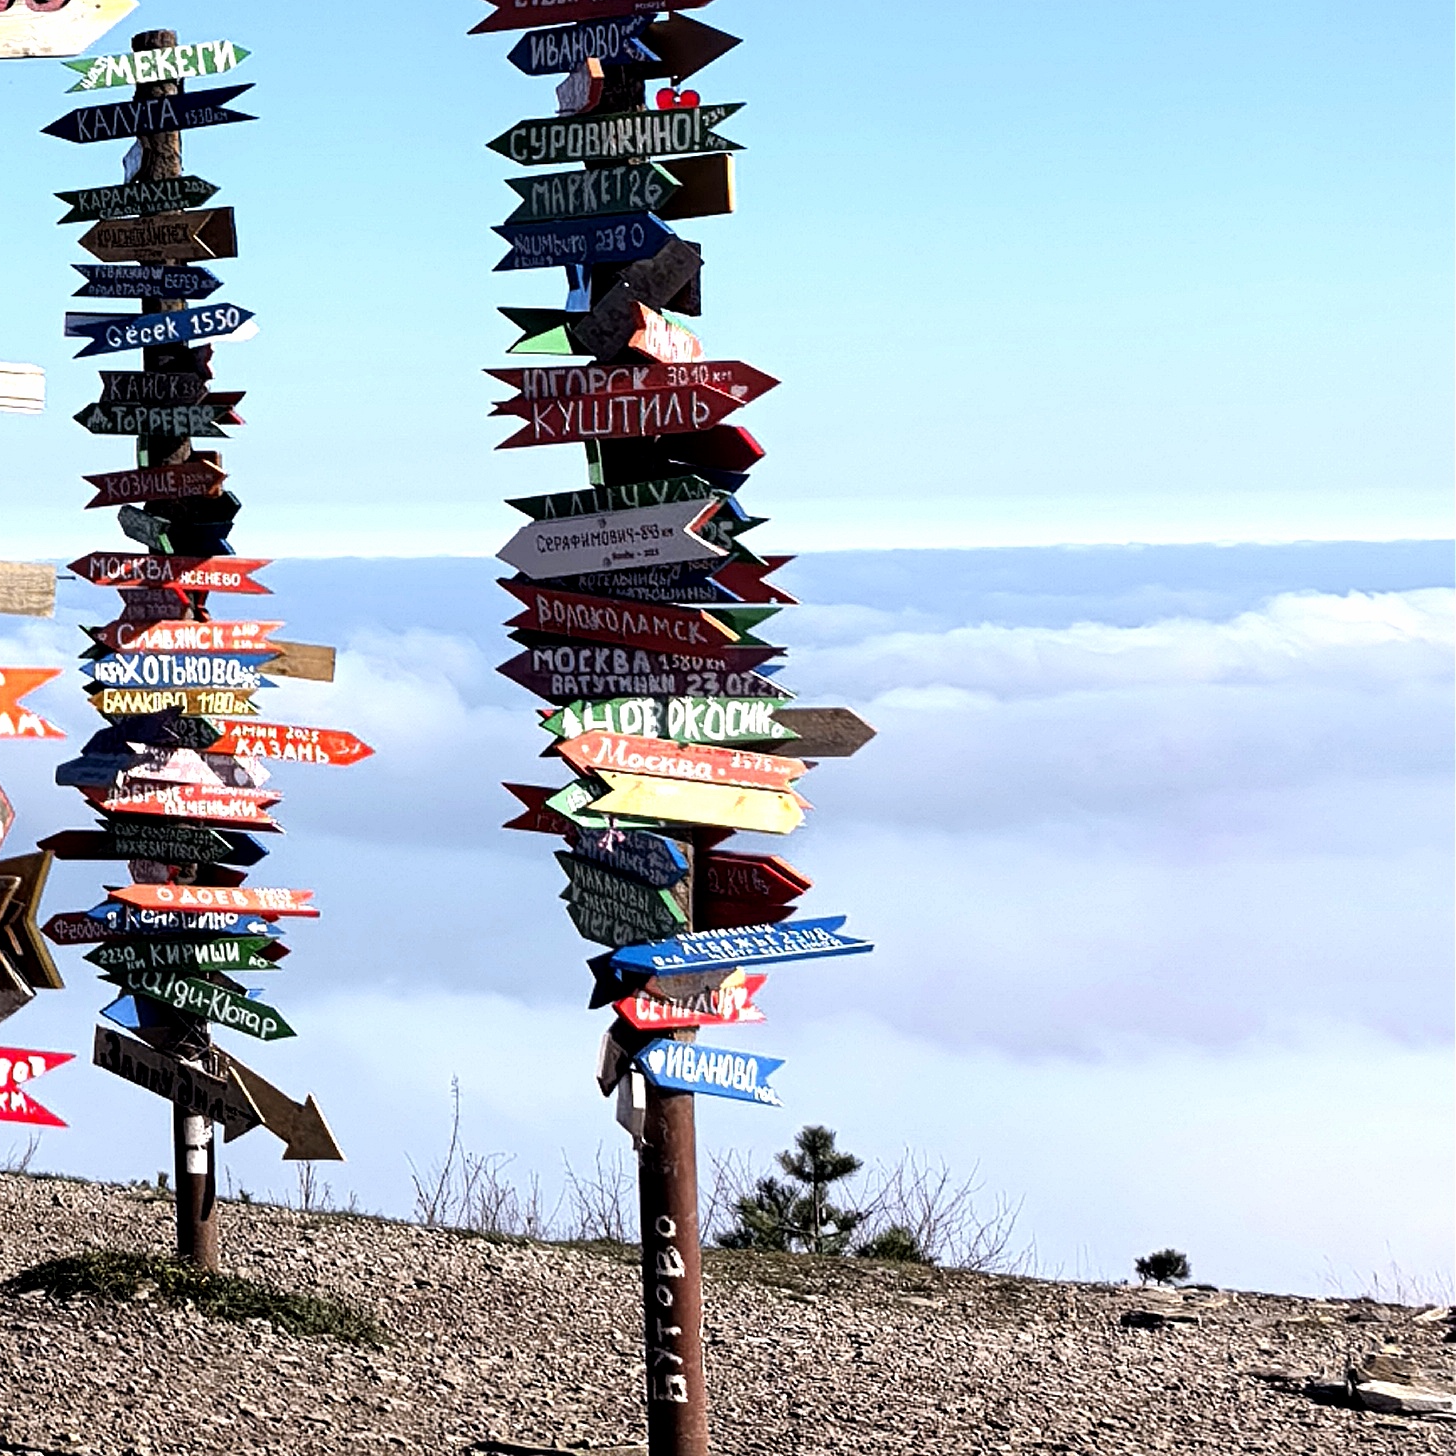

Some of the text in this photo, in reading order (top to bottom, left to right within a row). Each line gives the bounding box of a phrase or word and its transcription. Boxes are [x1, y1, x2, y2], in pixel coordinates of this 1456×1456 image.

[530, 23, 620, 70] ИВАНОВО
[105, 40, 237, 86] МЕКЕГИ
[76, 98, 179, 141] КАЛУГА
[191, 308, 240, 335] 1550
[533, 391, 710, 439] КУШТИЛЬ
[89, 555, 175, 580] МОСКВА
[535, 595, 709, 646] ВОЛОКОЛАМСК
[116, 623, 225, 650] СЛАВЯНСК
[532, 647, 651, 675] МОСКВА
[235, 739, 331, 765] КАЗАНЬ
[156, 886, 250, 907] ОДОЕВ
[148, 940, 241, 970] КИРИШИ
[665, 1043, 757, 1092] ИВАНОВО
